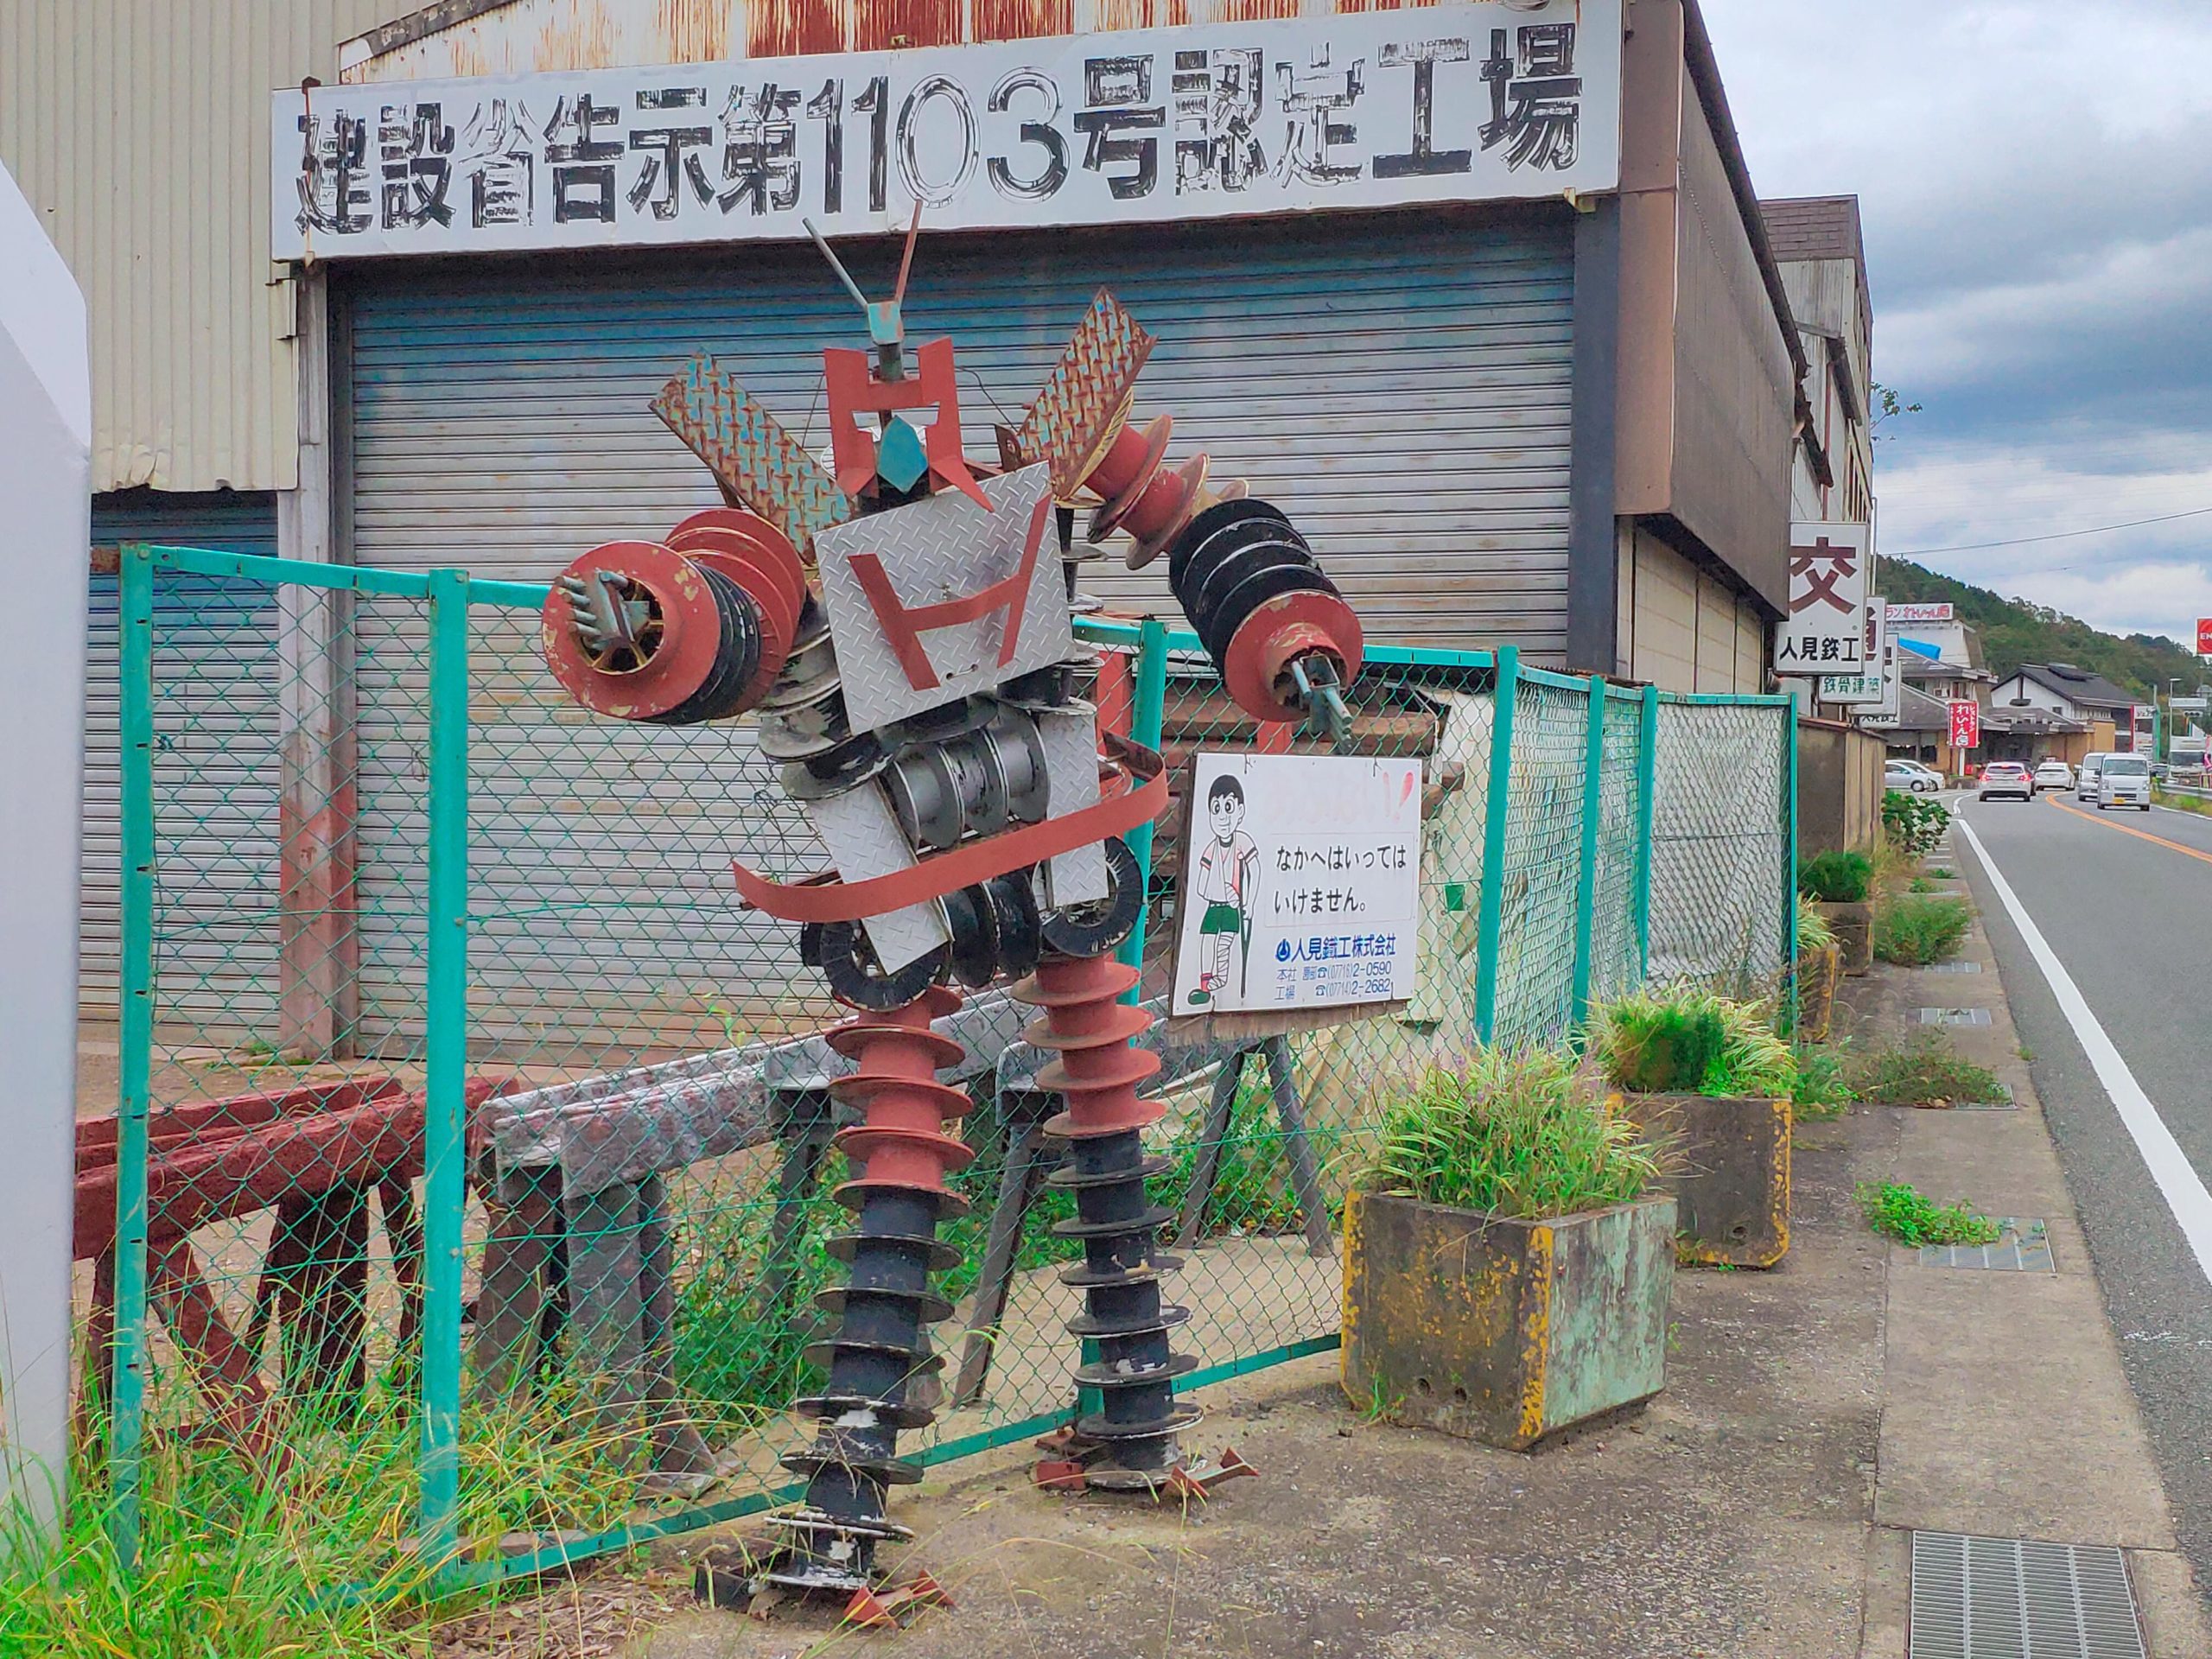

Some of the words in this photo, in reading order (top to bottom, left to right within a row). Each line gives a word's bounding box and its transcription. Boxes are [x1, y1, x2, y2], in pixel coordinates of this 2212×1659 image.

[1789, 537, 1857, 614] 交
[1779, 636, 1859, 662] 人見鉄工
[1276, 844, 1406, 872] なかへはいっては
[1274, 887, 1365, 914] いけません。
[1276, 967, 1296, 982] 本社
[1274, 984, 1295, 1001] 工場
